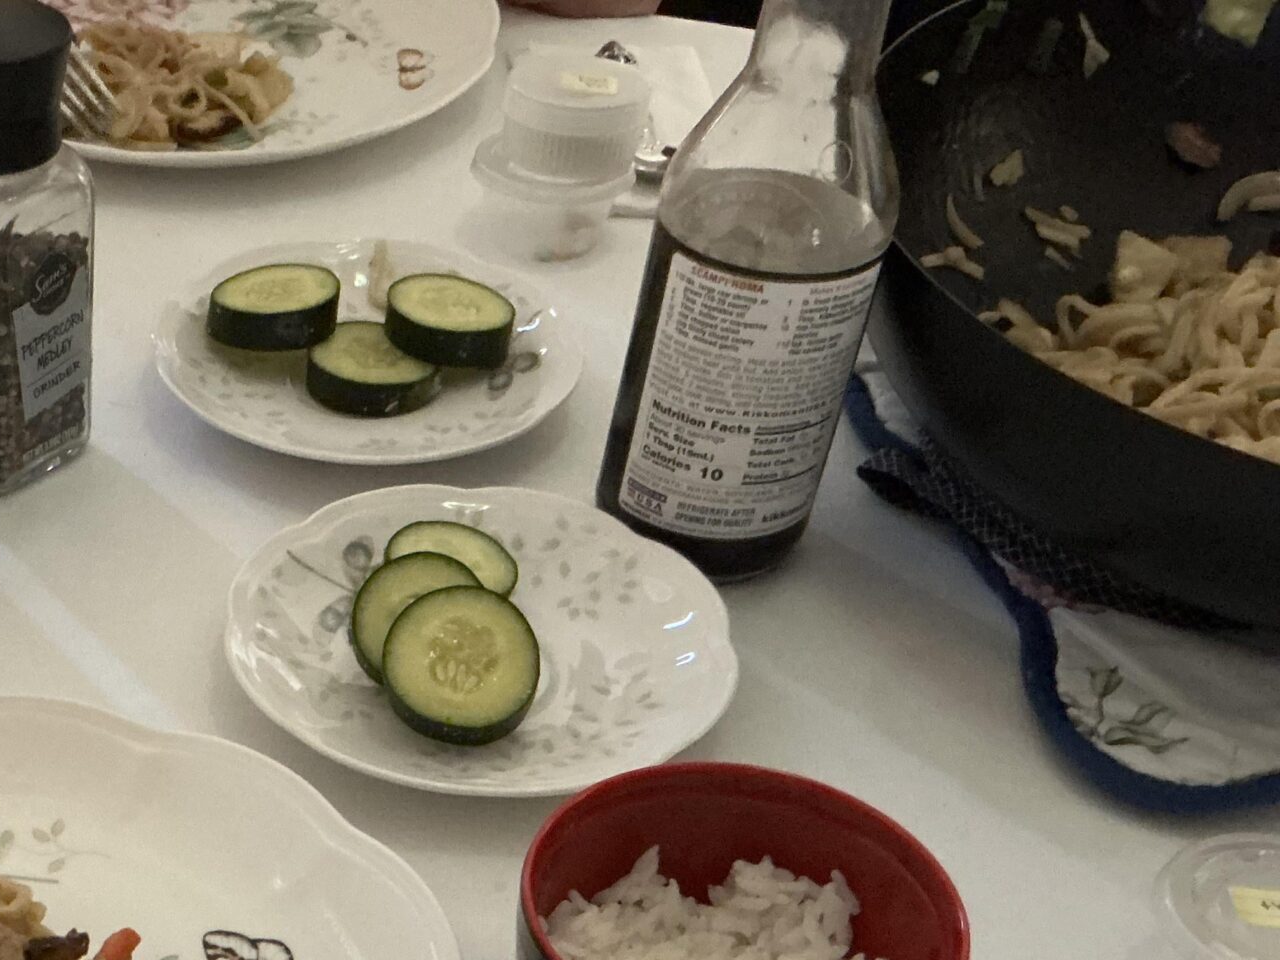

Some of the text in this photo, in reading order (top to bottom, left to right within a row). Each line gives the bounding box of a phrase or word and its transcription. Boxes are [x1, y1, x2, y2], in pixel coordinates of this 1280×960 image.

[20, 307, 85, 361] PEPPERCORN
[36, 334, 73, 371] MEDLEY
[32, 360, 82, 400] GRINDER
[652, 398, 751, 434] Nutrition Facts
[672, 433, 696, 447] Size
[753, 437, 778, 445] Total
[642, 443, 724, 482] Calories 10
[747, 460, 772, 469] Total
